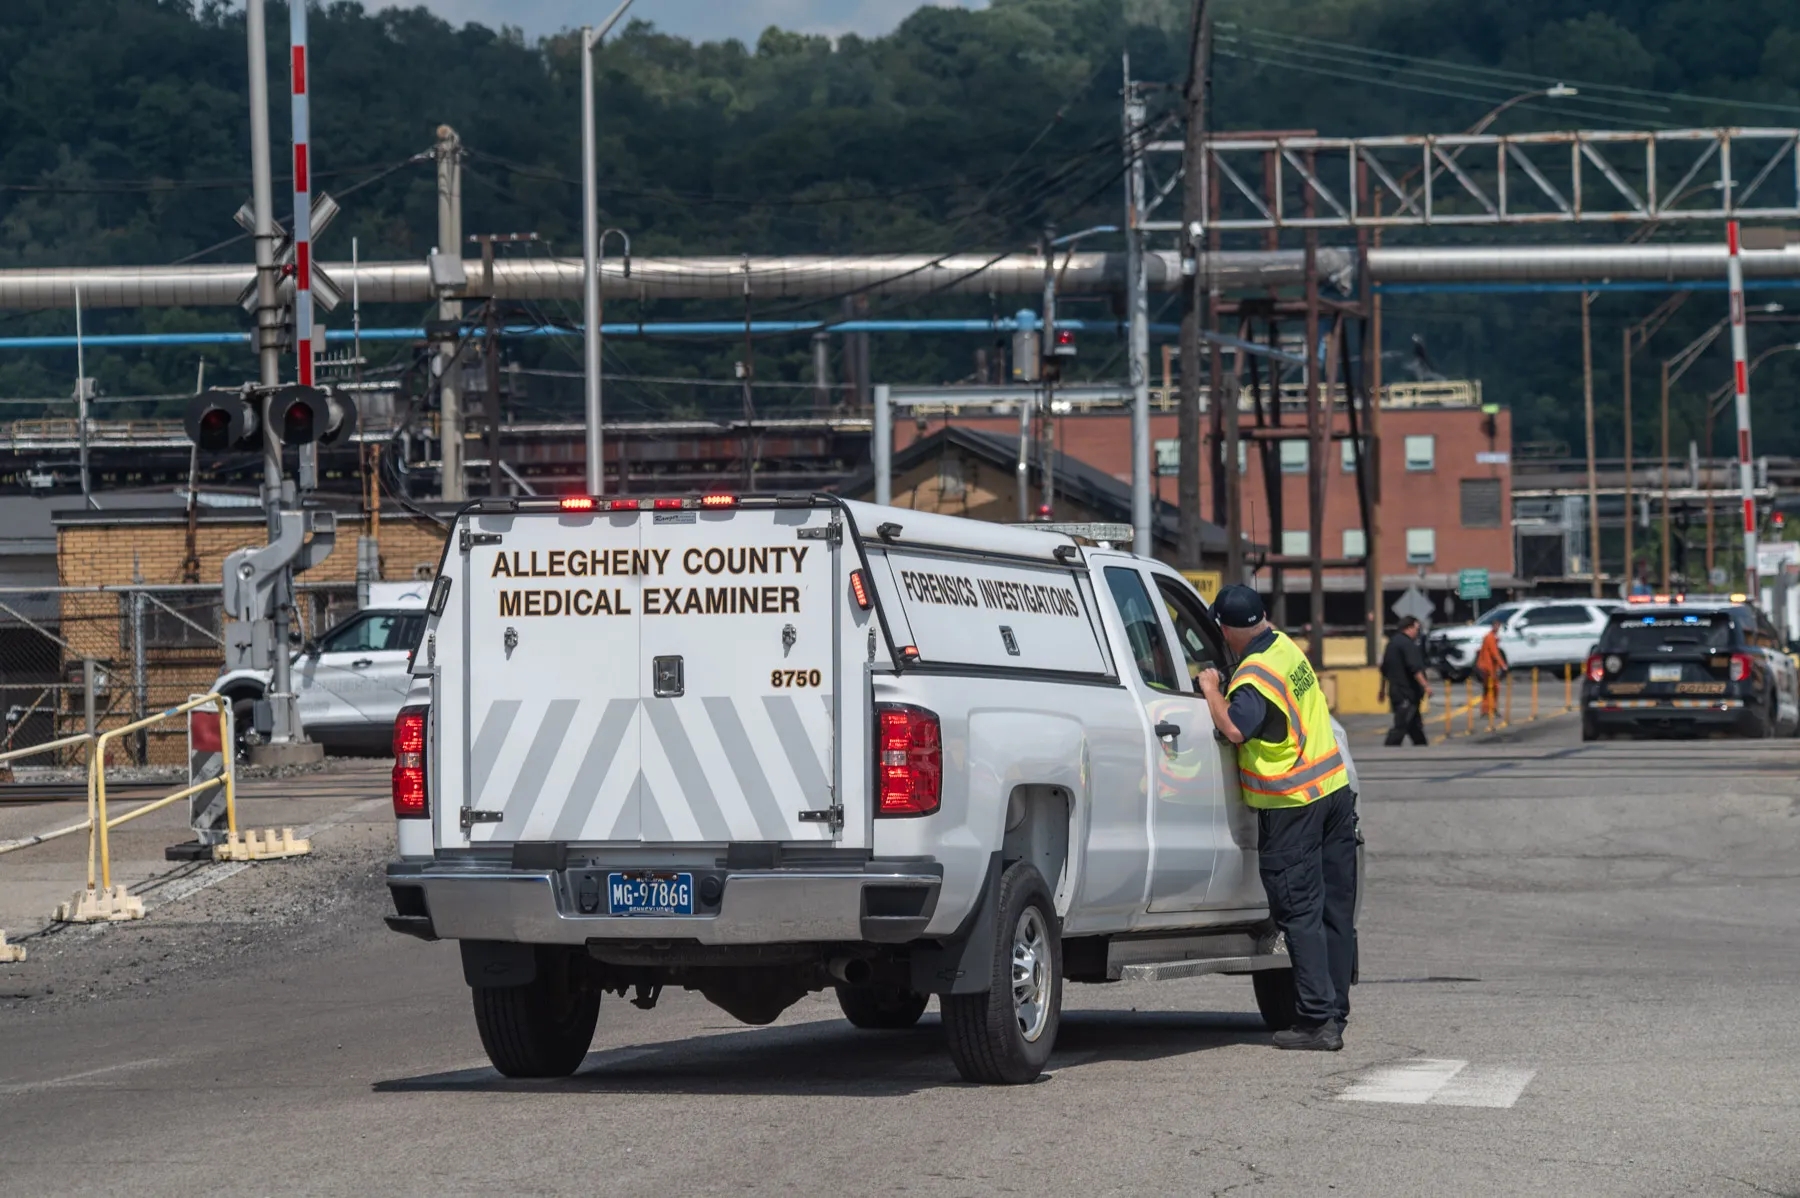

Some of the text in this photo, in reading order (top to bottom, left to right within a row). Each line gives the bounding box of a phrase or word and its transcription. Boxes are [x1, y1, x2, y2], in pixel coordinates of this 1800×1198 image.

[491, 547, 809, 578] ALLEGHENY COUNTY
[500, 587, 800, 616] MEDICAL EXAMINER
[901, 570, 1079, 617] FORENSICS INVESTIGATIONS
[772, 669, 821, 688] 8750
[613, 883, 688, 906] MG-9786G
